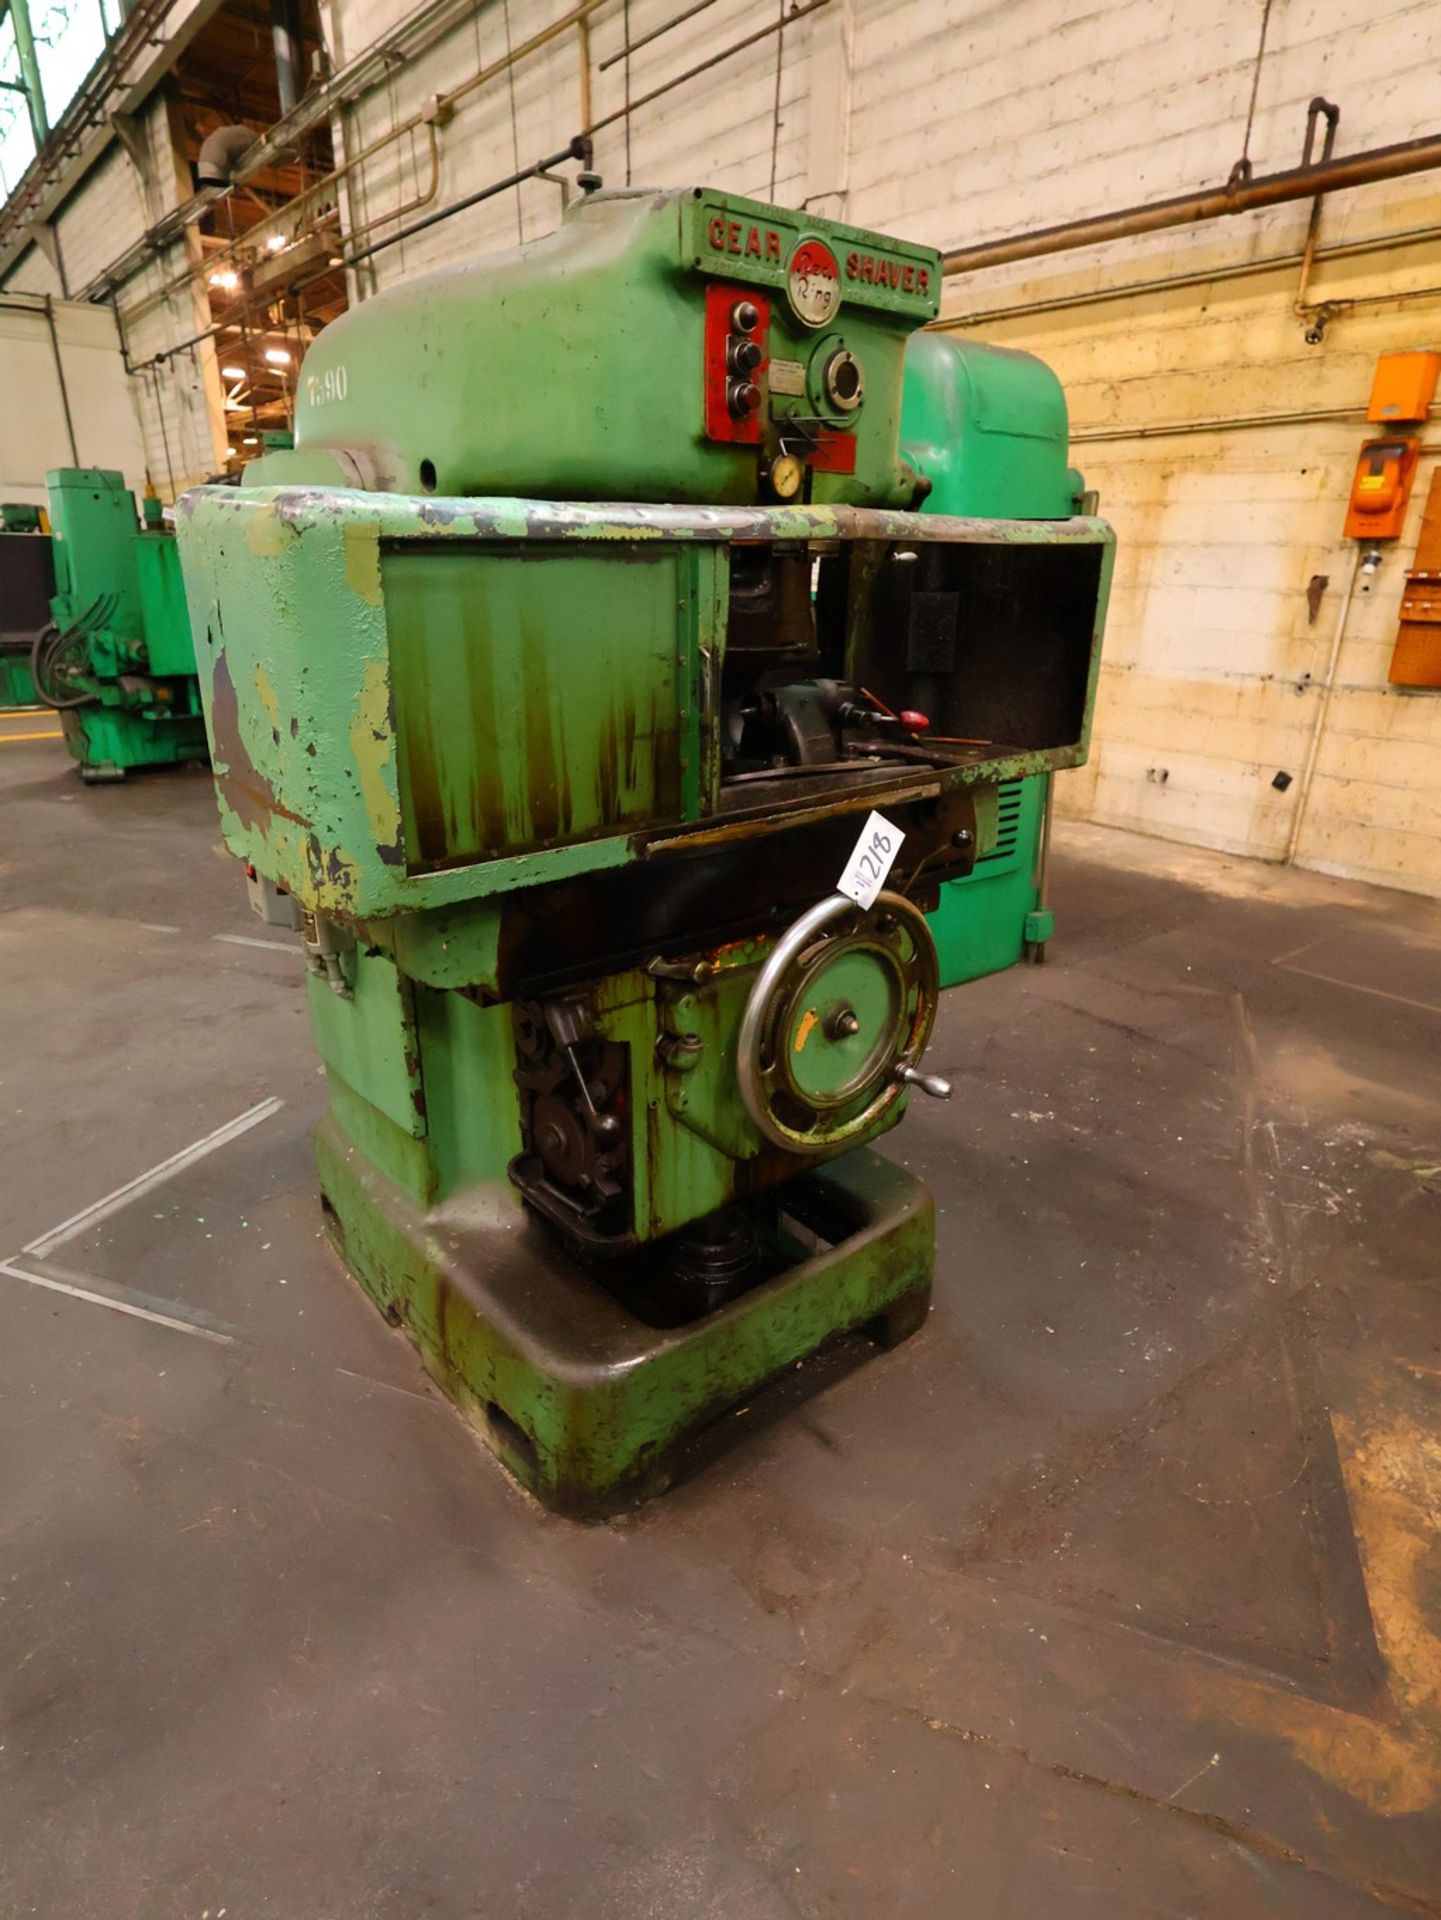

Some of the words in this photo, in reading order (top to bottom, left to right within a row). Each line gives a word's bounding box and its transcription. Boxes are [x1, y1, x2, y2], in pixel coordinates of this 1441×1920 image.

[709, 217, 781, 264] GEAR
[845, 250, 929, 297] SHAVER
[798, 276, 832, 310] Ring
[859, 831, 892, 880] 218
